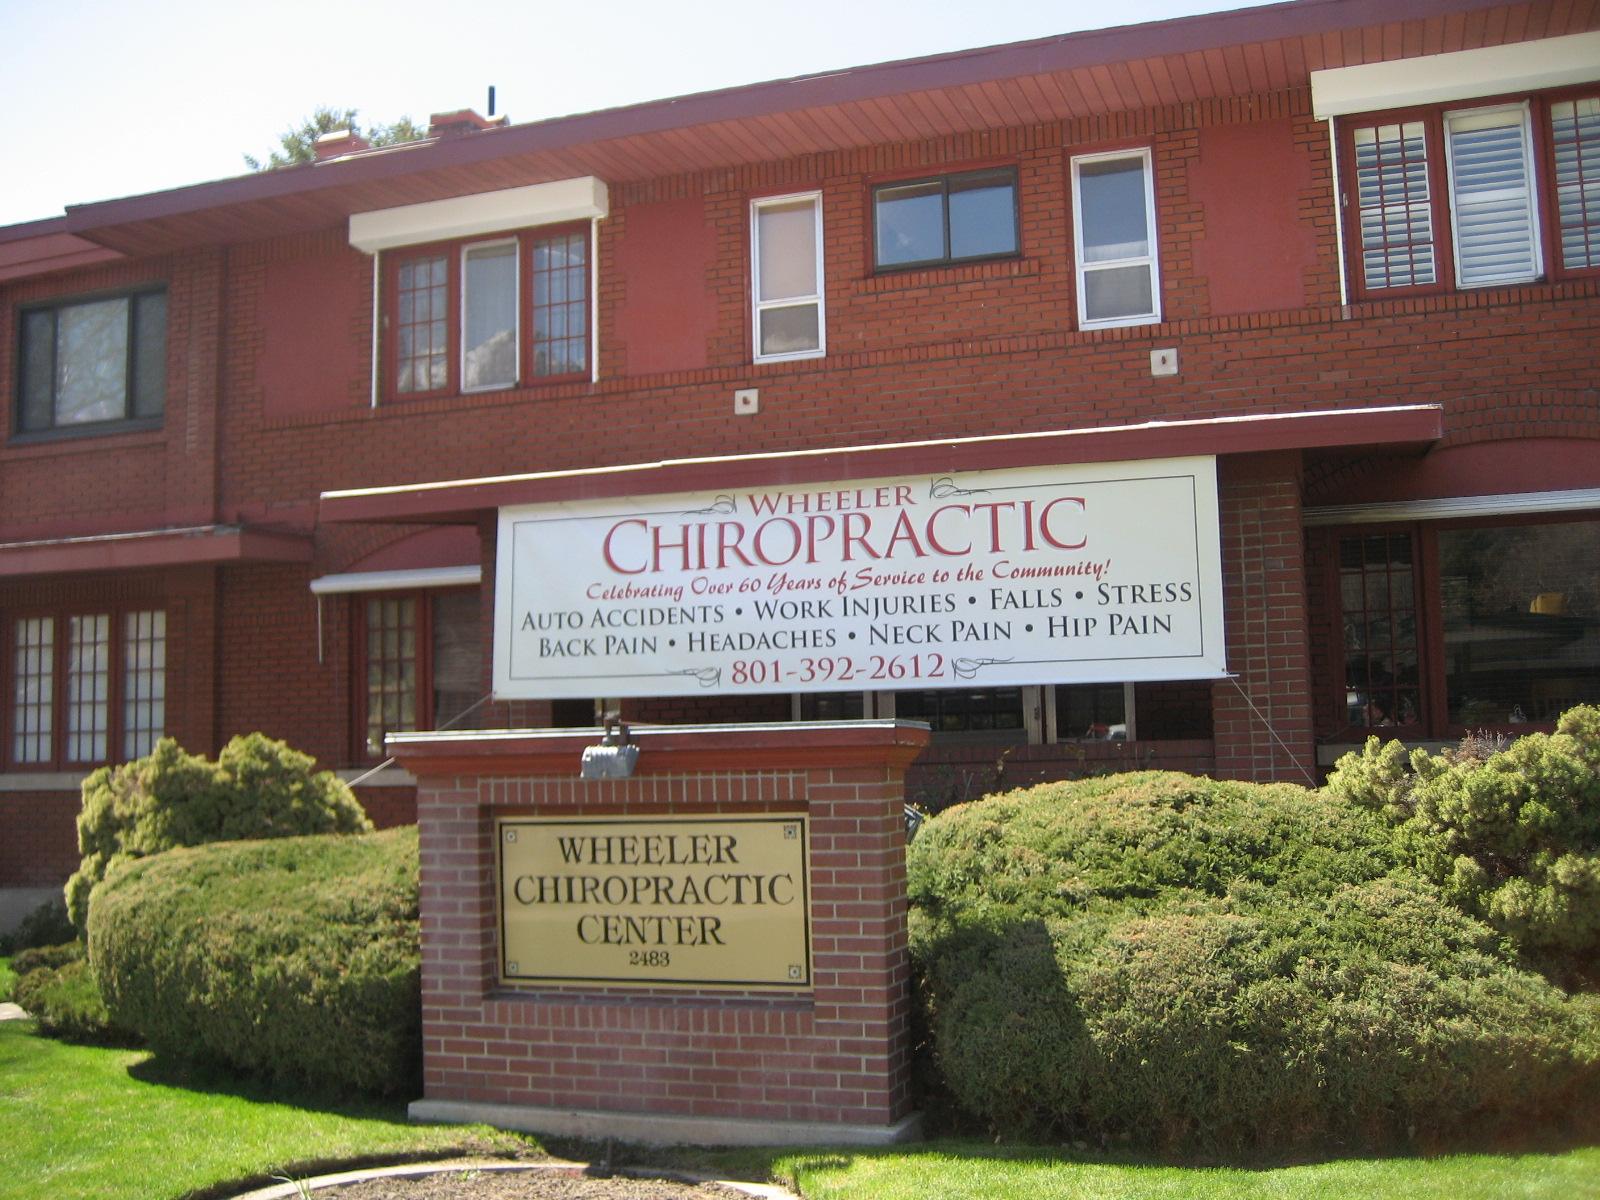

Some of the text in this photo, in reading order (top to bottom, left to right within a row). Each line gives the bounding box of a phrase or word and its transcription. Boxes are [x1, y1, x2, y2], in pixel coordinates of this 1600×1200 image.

[748, 485, 917, 516] WHEELER
[603, 497, 1088, 575] CHIROPRACTIC
[586, 558, 1112, 601] Celebrating Over 60 Years of Service to the Community!
[521, 581, 1193, 631] AUTO ACCIDENTS WORK INJURIES FALLS STRESS
[539, 613, 1173, 658] BACK PAIN HEADACHES NECK PAIN HIP PAIN
[731, 653, 945, 685] 801-392-2612
[557, 834, 740, 866] WHEELER
[513, 873, 795, 905] CHIROPRACTIC
[576, 915, 727, 945] CENTER
[628, 951, 671, 968] 2483
